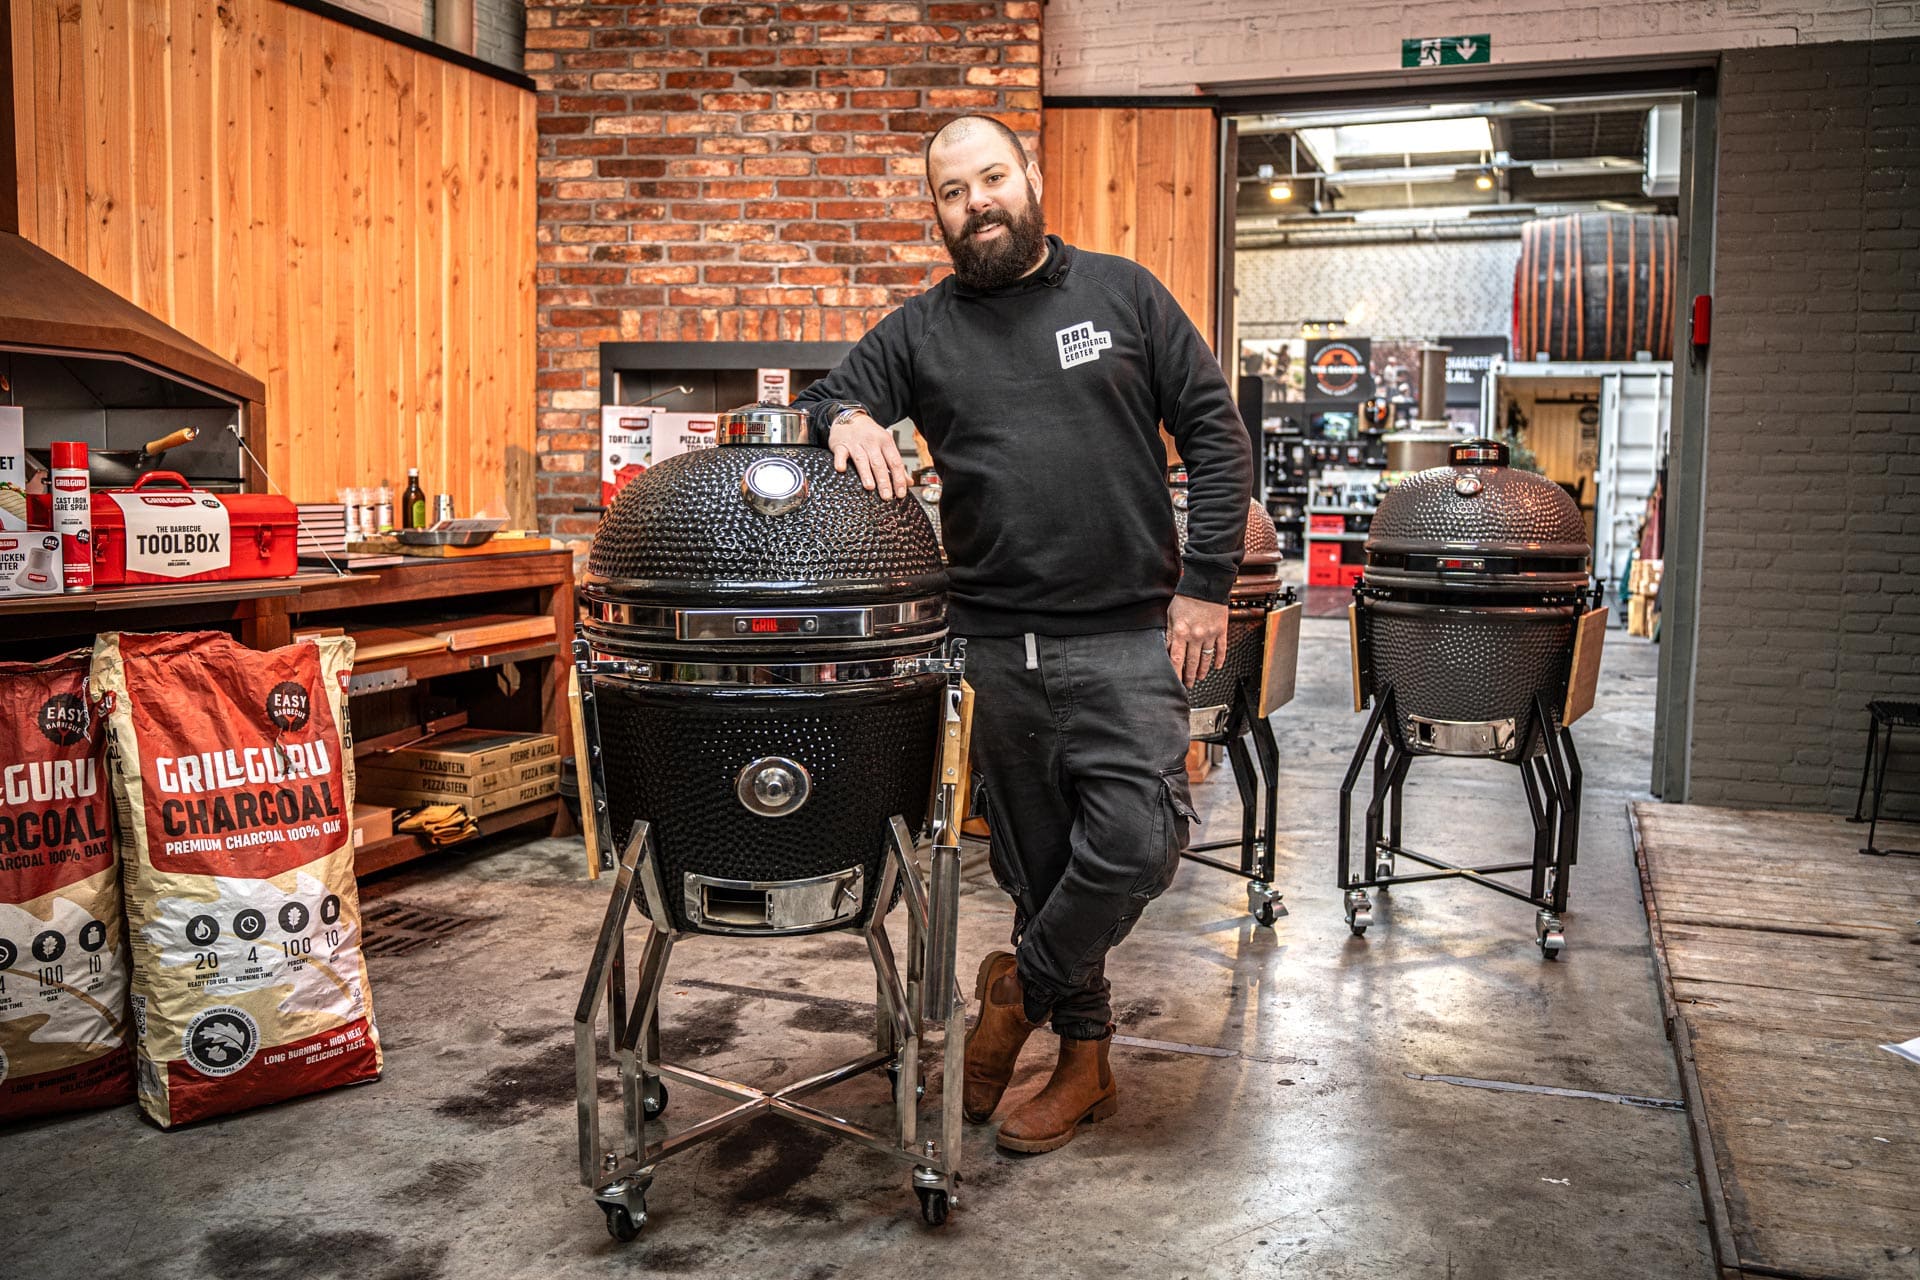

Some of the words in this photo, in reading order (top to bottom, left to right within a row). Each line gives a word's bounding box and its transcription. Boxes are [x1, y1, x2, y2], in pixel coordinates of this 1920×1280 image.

[1062, 327, 1089, 345] BBQ
[1064, 337, 1107, 355] EXPERIENCE
[1065, 348, 1093, 362] CENTER
[608, 435, 642, 444] TORTILLA
[680, 435, 701, 444] PIZZA
[156, 525, 168, 533] THE
[170, 525, 202, 533] BARBECUE
[136, 533, 220, 555] TOOLBOX
[274, 693, 307, 709] EASY
[47, 706, 84, 722] EASY
[273, 707, 306, 720] BARBECUE
[537, 743, 555, 755] PIZZA
[156, 739, 331, 794] GRILLGURU
[420, 759, 465, 774] PIZZASTEIN
[521, 768, 539, 781] PIZZA
[0, 758, 97, 806] GURU
[422, 779, 468, 794] PIZZASTEEN
[520, 787, 538, 800] PIZZA
[162, 781, 340, 837] CHARCOAL
[166, 838, 222, 856] PREMIUM
[226, 830, 285, 850] CHARCOAL
[287, 822, 320, 842] 100%
[323, 819, 341, 834] OAK
[49, 848, 81, 865] 100%
[84, 840, 109, 858] OAK
[325, 929, 339, 948] 10
[247, 946, 259, 963] 4
[282, 937, 311, 958] 100
[89, 954, 101, 974] 10
[194, 951, 218, 970] 20
[287, 957, 308, 967] PERCENT
[39, 964, 64, 987] 100
[235, 974, 260, 982] BURNING
[261, 971, 274, 980] TIME
[245, 966, 263, 974] HOURS
[9, 1002, 23, 1010] TIME
[264, 1053, 286, 1065] LONG
[288, 1042, 322, 1060] BURNING
[329, 1035, 347, 1048] HIGH
[347, 1027, 362, 1040] HEAT
[306, 1046, 344, 1064] DELICIOUS
[346, 1038, 366, 1052] TASTE
